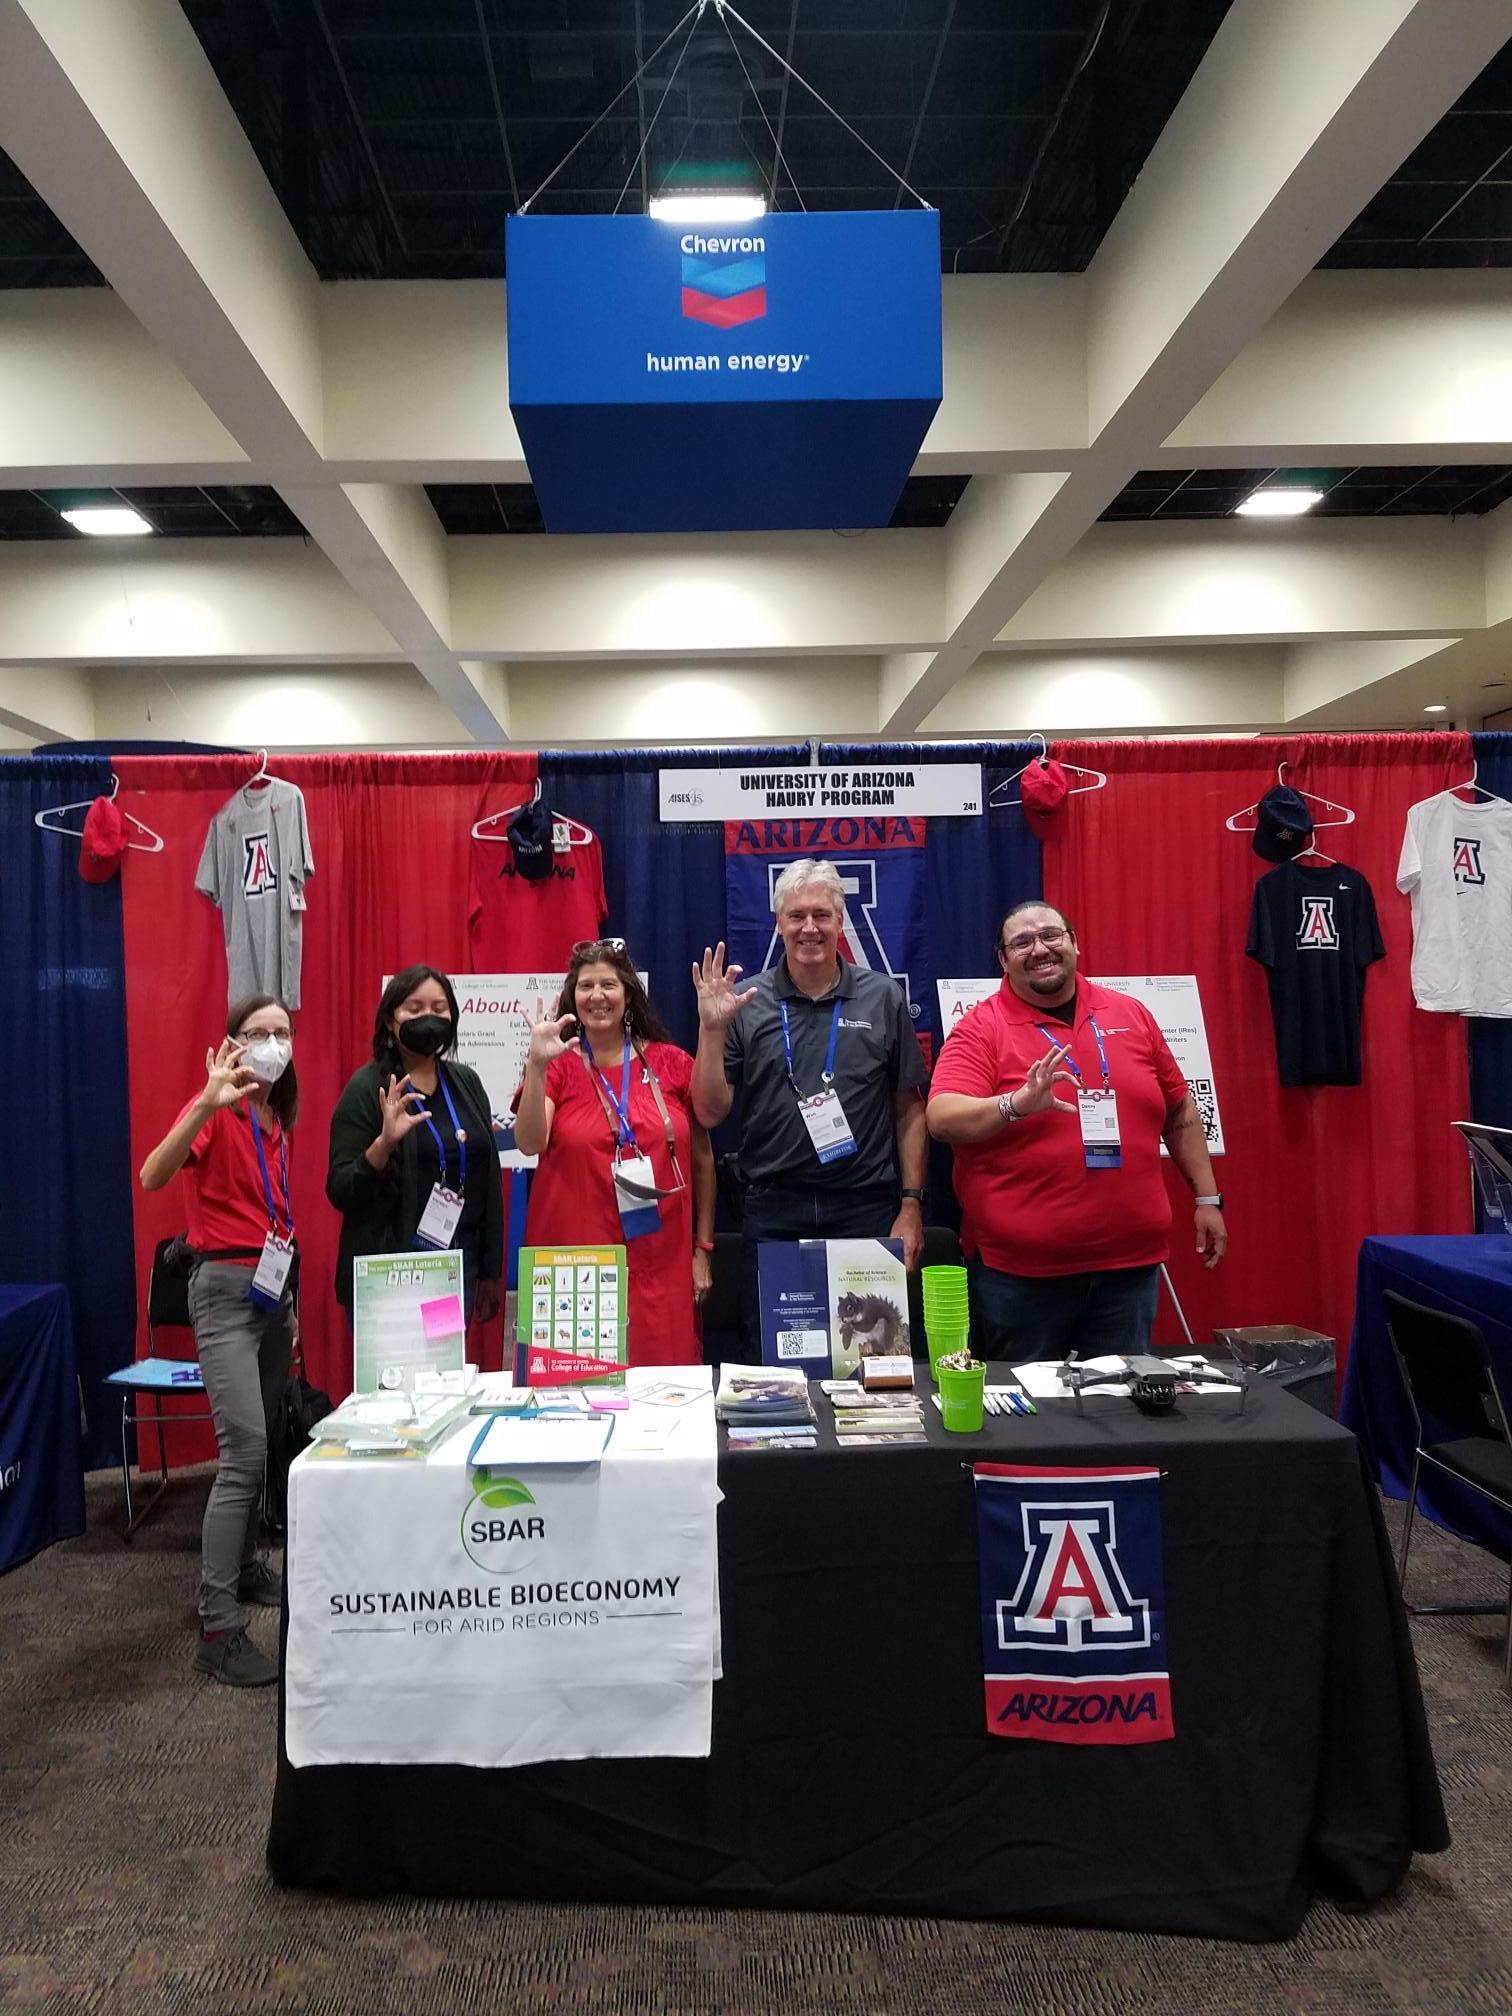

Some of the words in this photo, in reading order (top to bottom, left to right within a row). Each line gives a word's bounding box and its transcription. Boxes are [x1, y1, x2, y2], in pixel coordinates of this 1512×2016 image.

[680, 234, 765, 253] Chevron
[646, 353, 720, 372] human
[727, 354, 804, 372] energy
[740, 773, 827, 791] UNIVERSITY
[831, 773, 849, 788] OF
[852, 771, 915, 788] ARIZONA
[668, 793, 691, 803] AISES
[765, 791, 815, 807] HAURY
[821, 790, 895, 806] PROGRAM
[963, 802, 977, 811] 241
[735, 817, 916, 849] ARIZONA
[551, 1364, 572, 1373] College
[470, 1517, 546, 1543] SBAR
[996, 1500, 1150, 1652] A
[330, 1586, 501, 1616] SUSTAINABLE
[511, 1576, 681, 1606] BIOECONOMY
[412, 1619, 453, 1636] FOR
[459, 1617, 504, 1633] ARID
[511, 1611, 599, 1630] REGIONS
[997, 1692, 1157, 1725] ARIZONA
